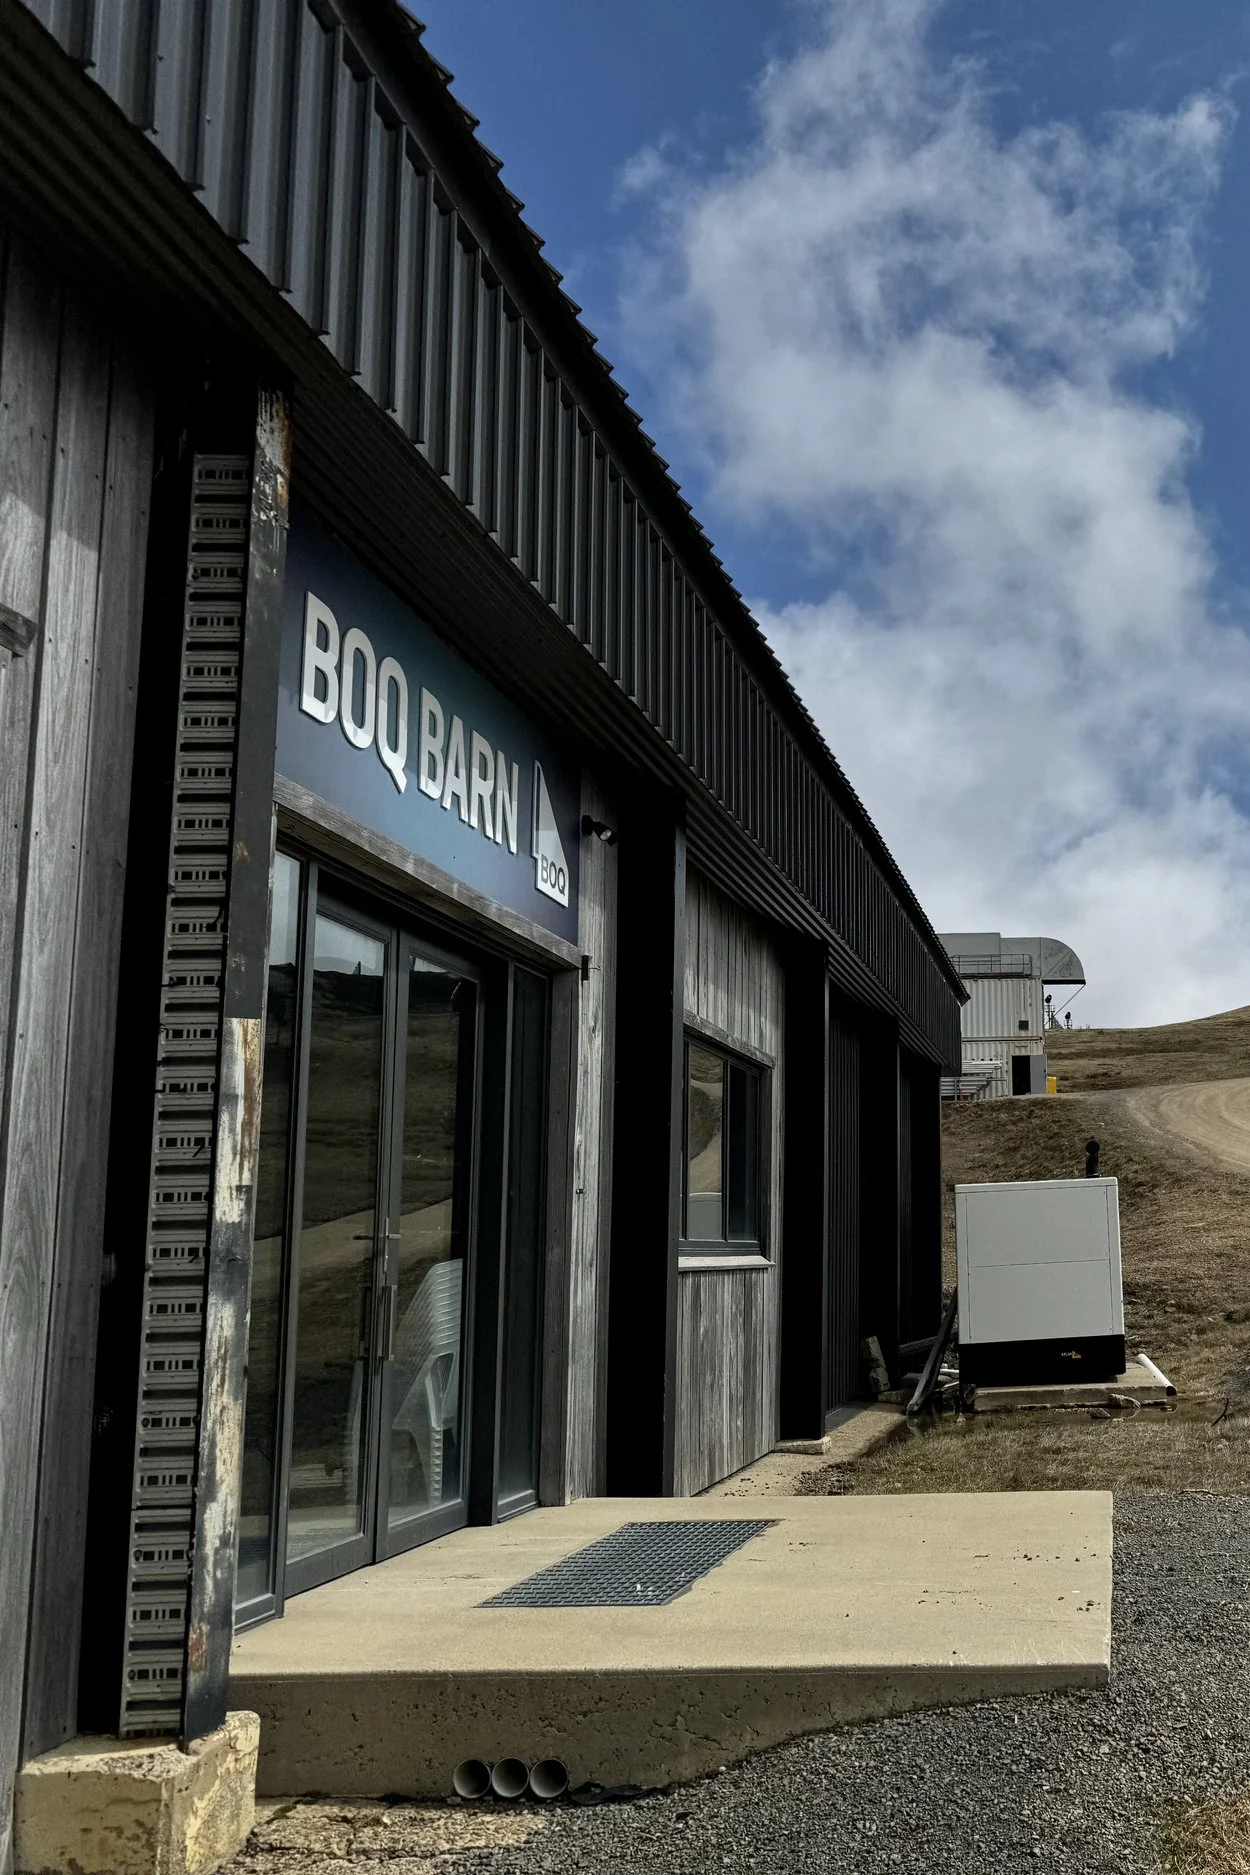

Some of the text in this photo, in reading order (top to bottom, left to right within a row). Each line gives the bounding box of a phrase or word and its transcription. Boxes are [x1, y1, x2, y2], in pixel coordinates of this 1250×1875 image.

[300, 591, 519, 855] BOQ BARN
[540, 854, 566, 895] BOQ
